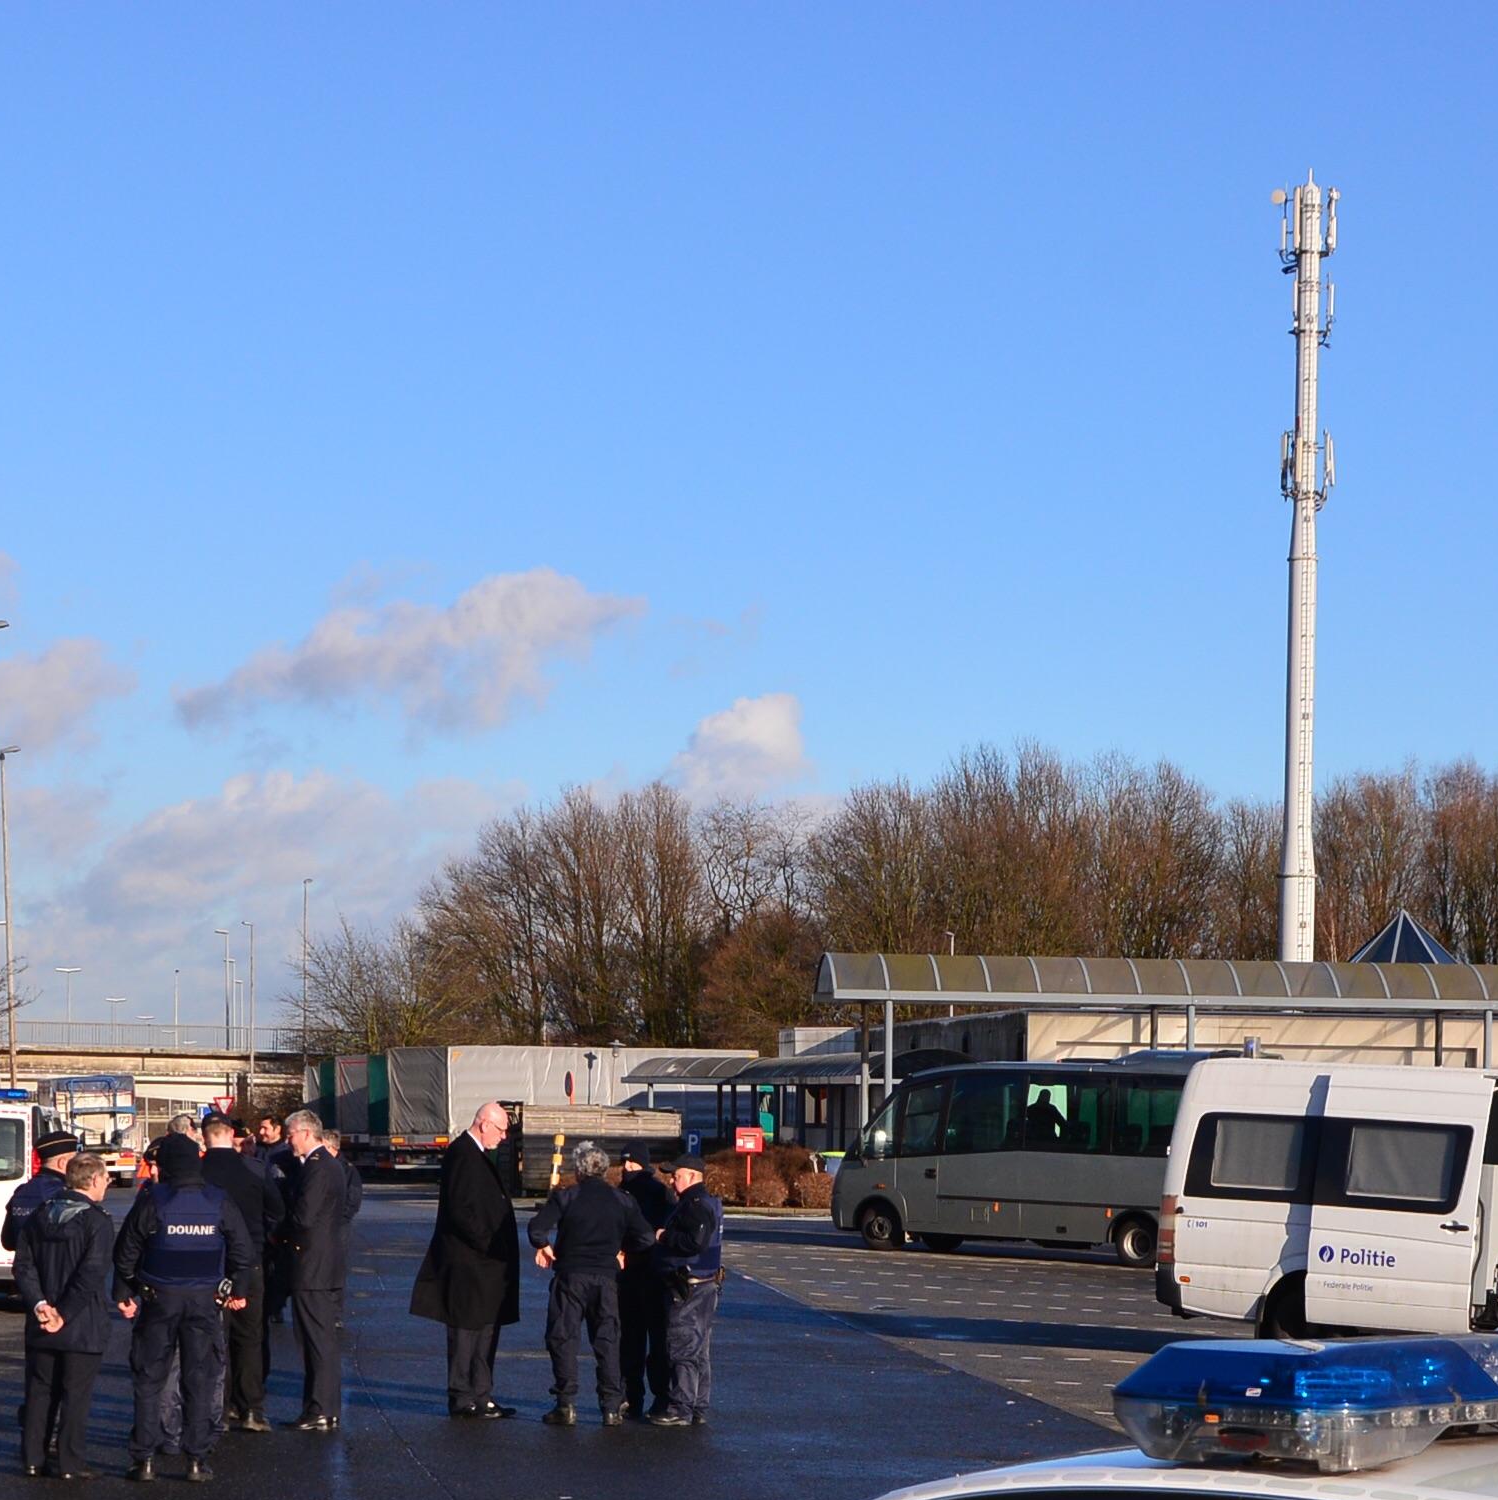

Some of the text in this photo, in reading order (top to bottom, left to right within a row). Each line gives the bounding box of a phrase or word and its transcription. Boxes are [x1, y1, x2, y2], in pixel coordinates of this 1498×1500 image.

[687, 1134, 699, 1153] P
[167, 1224, 216, 1236] DOUANE
[1195, 1220, 1208, 1229] 101
[1340, 1248, 1396, 1268] Politie
[1323, 1281, 1373, 1292] Federale Politie
